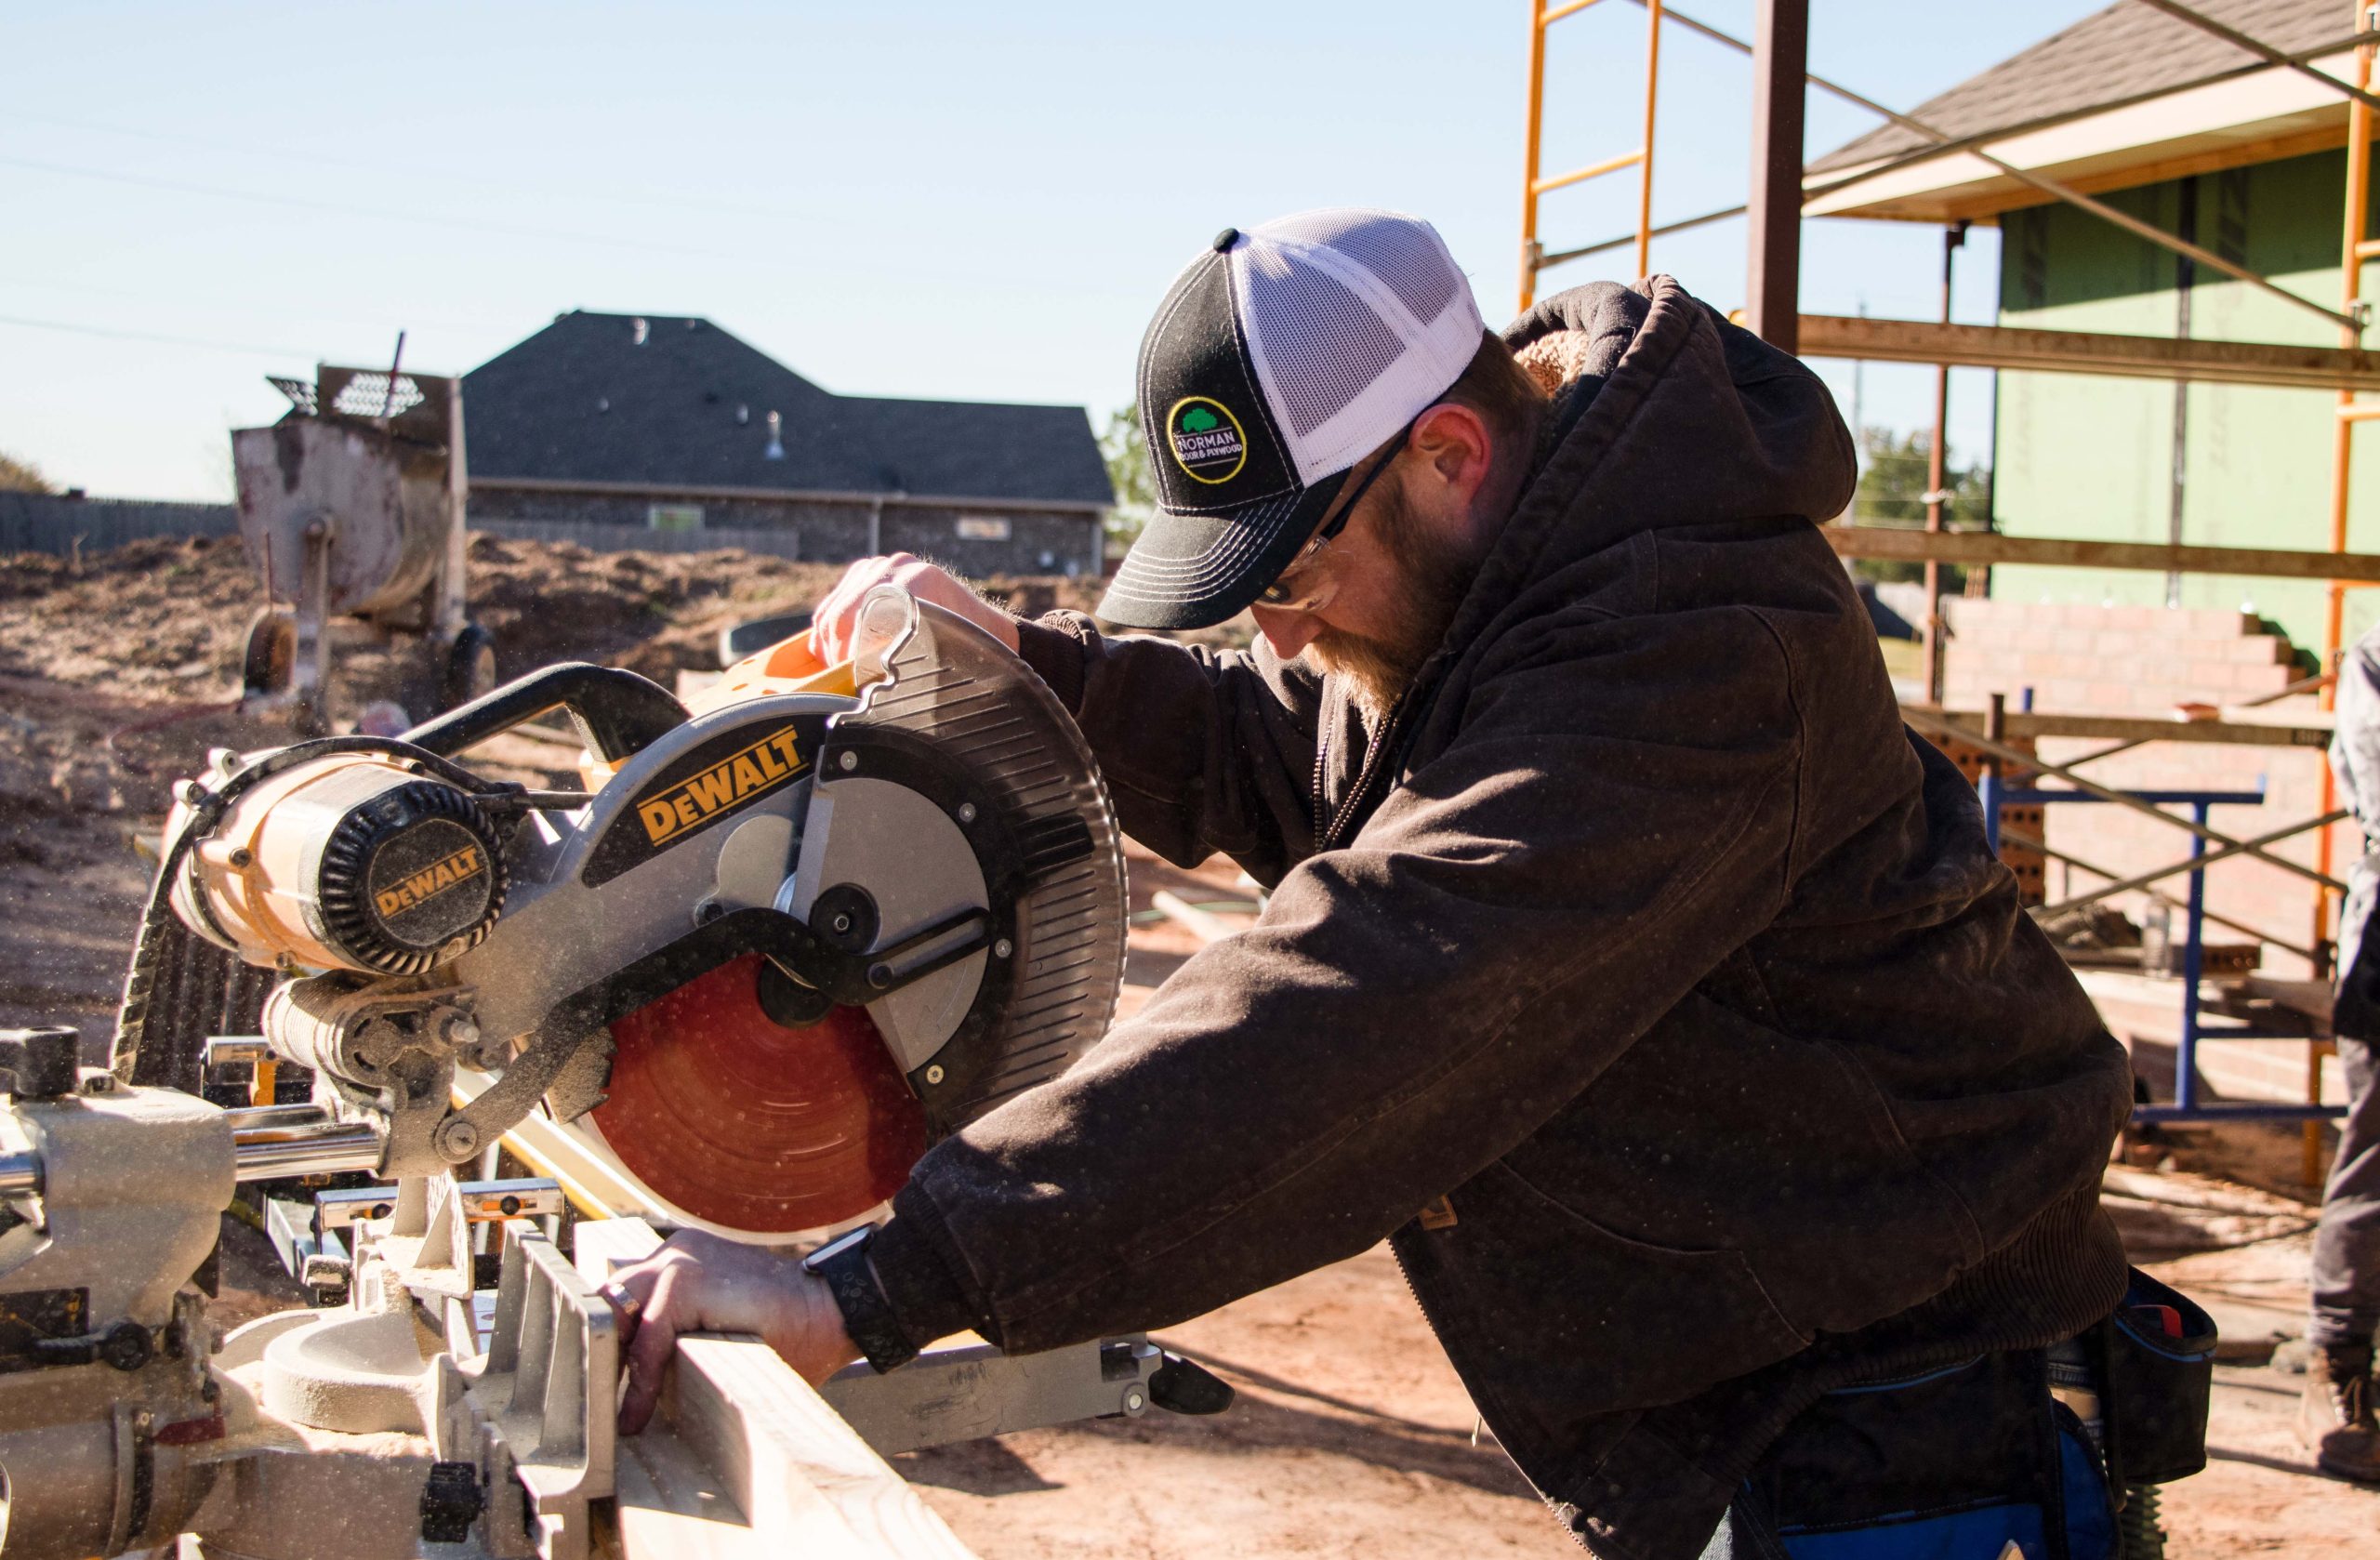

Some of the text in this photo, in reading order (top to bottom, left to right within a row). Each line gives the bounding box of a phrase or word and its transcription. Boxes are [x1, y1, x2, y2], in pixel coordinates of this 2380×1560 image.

[1177, 430, 1236, 452] NORMAN
[1206, 443, 1243, 458] PLYWOOD
[639, 729, 801, 842] DEWALT
[376, 847, 480, 918] DEWALT
